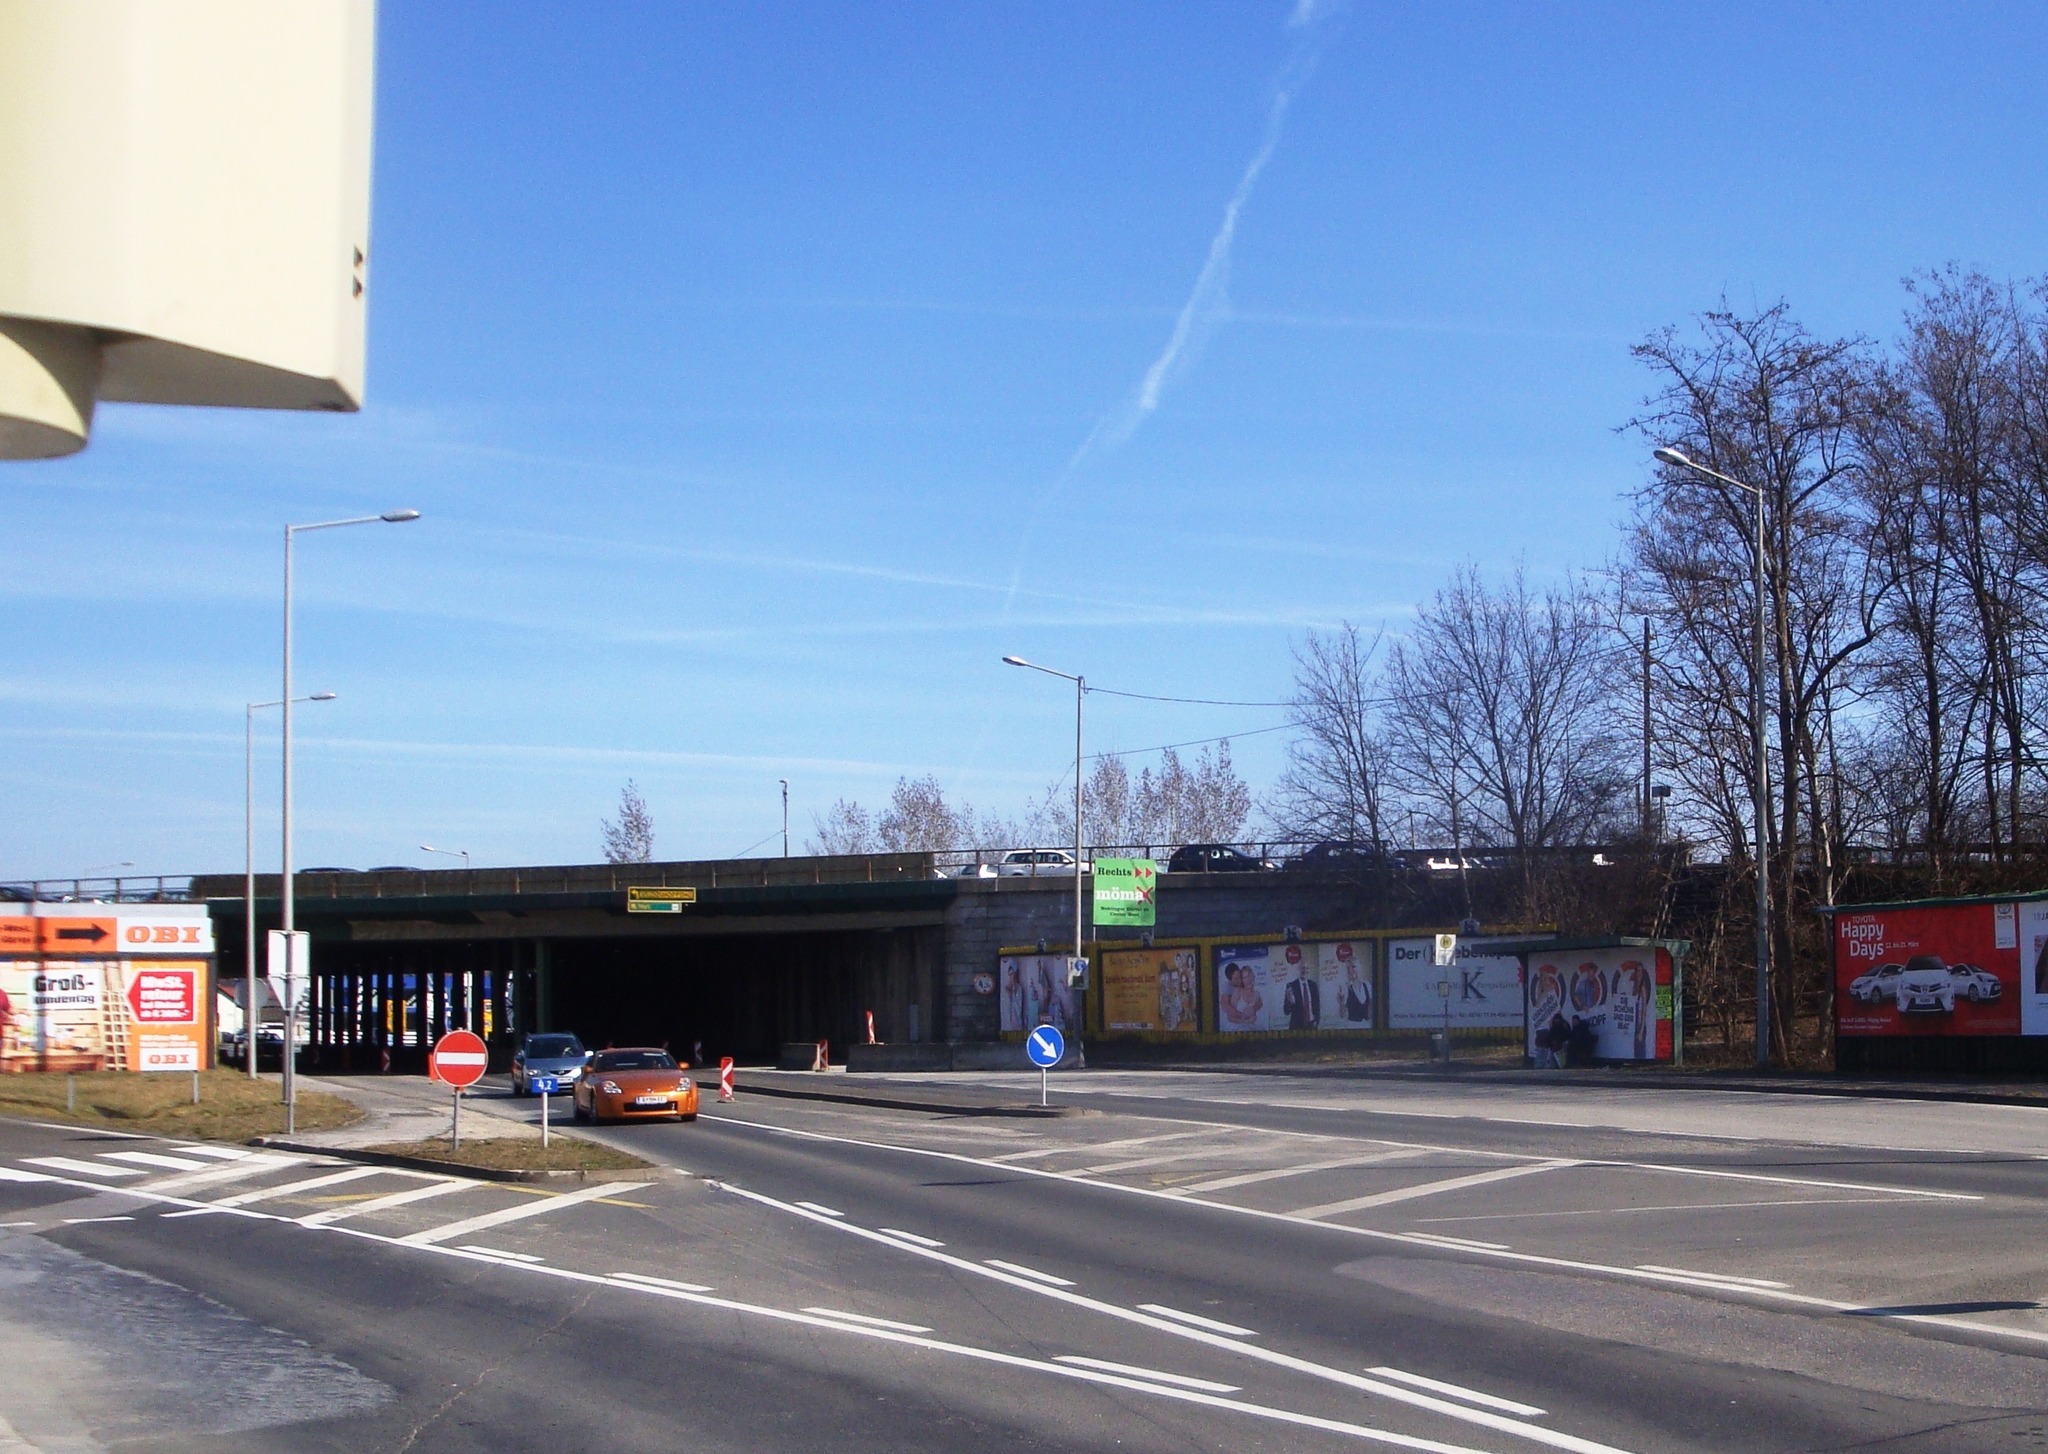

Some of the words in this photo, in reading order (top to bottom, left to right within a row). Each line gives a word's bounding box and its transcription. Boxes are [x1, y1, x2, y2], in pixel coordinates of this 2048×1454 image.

[1097, 867, 1132, 876] Rechts
[1852, 915, 1876, 923] TOYOTA
[125, 926, 201, 943] OBI
[1841, 921, 1884, 942] Happy
[1395, 947, 1421, 960] Der
[1850, 940, 1884, 960] Days
[35, 974, 94, 992] Groß-
[1461, 970, 1487, 999] K
[149, 1054, 190, 1064] OBI
